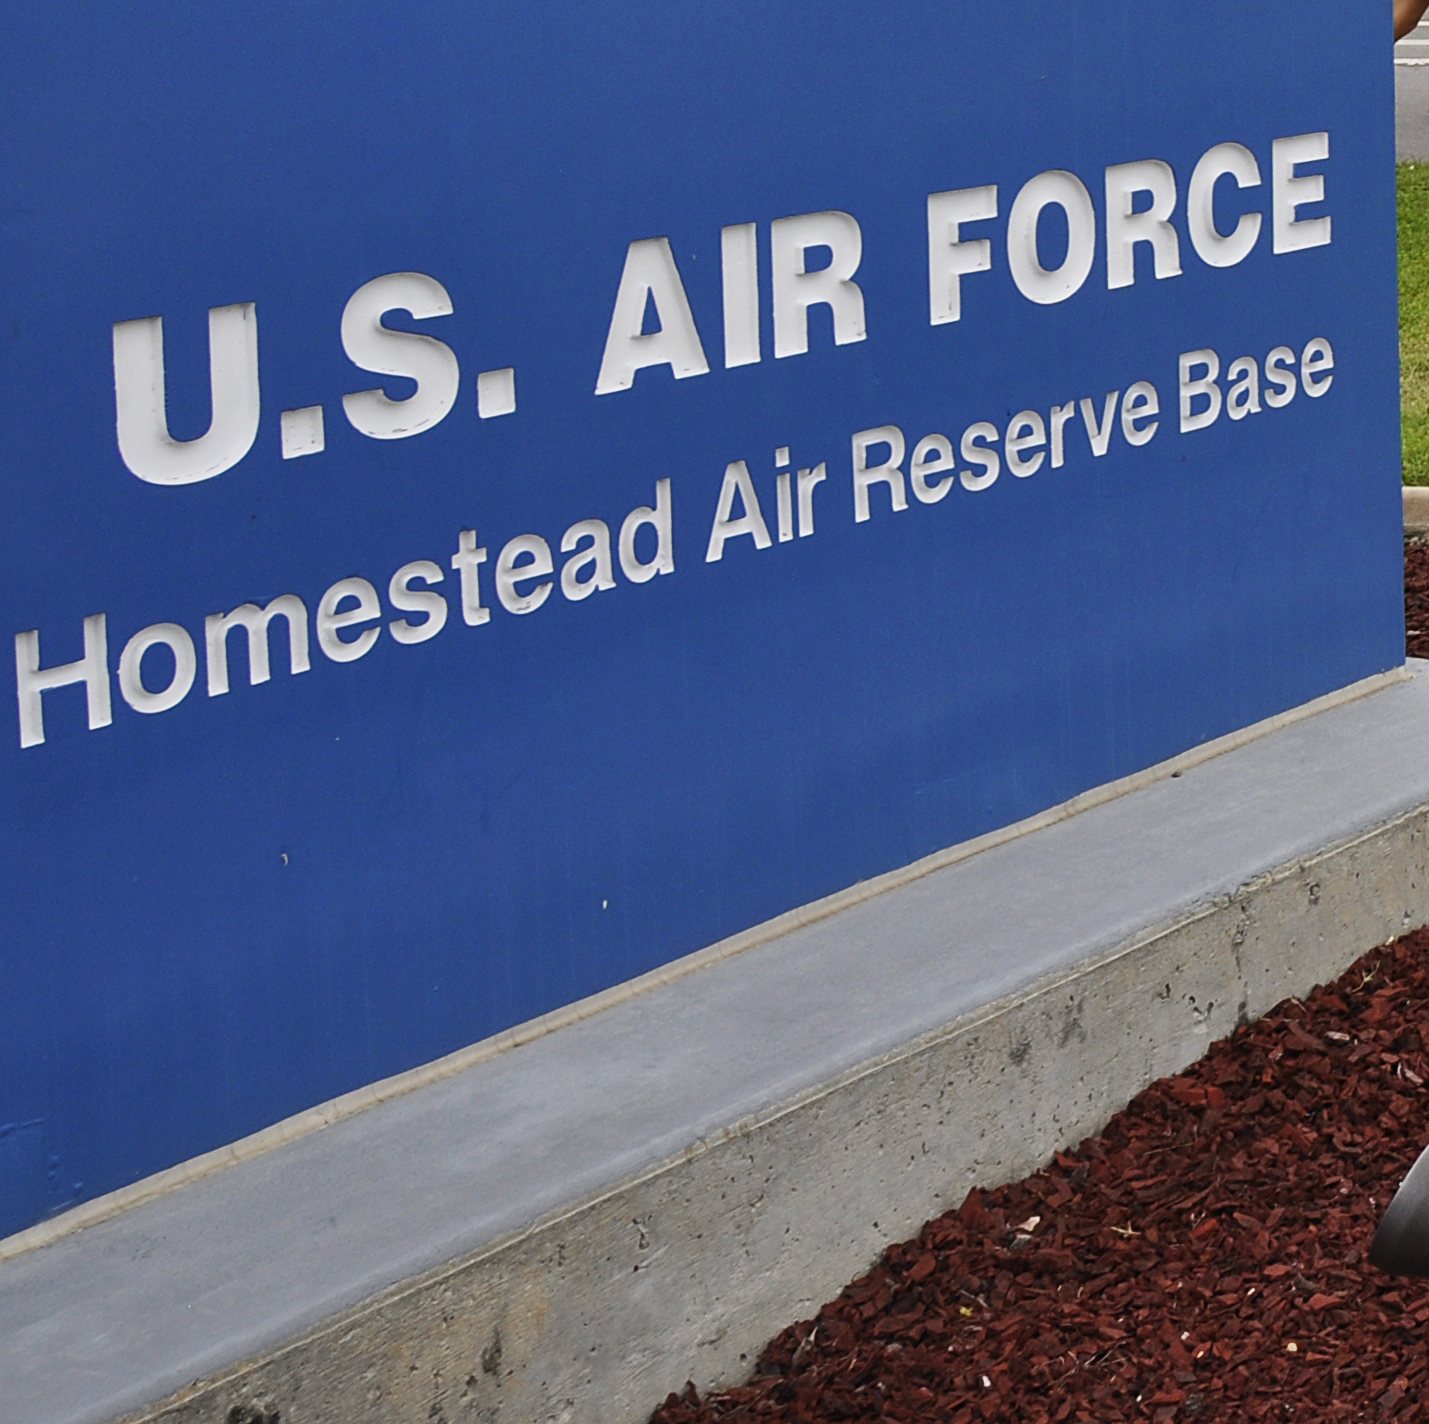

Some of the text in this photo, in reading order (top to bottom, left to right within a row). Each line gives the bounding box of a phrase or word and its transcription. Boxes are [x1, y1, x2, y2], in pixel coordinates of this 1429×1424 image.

[112, 131, 1332, 486] U.S. AIR FORCE
[15, 337, 1335, 749] Homestead Air Reserve Base
